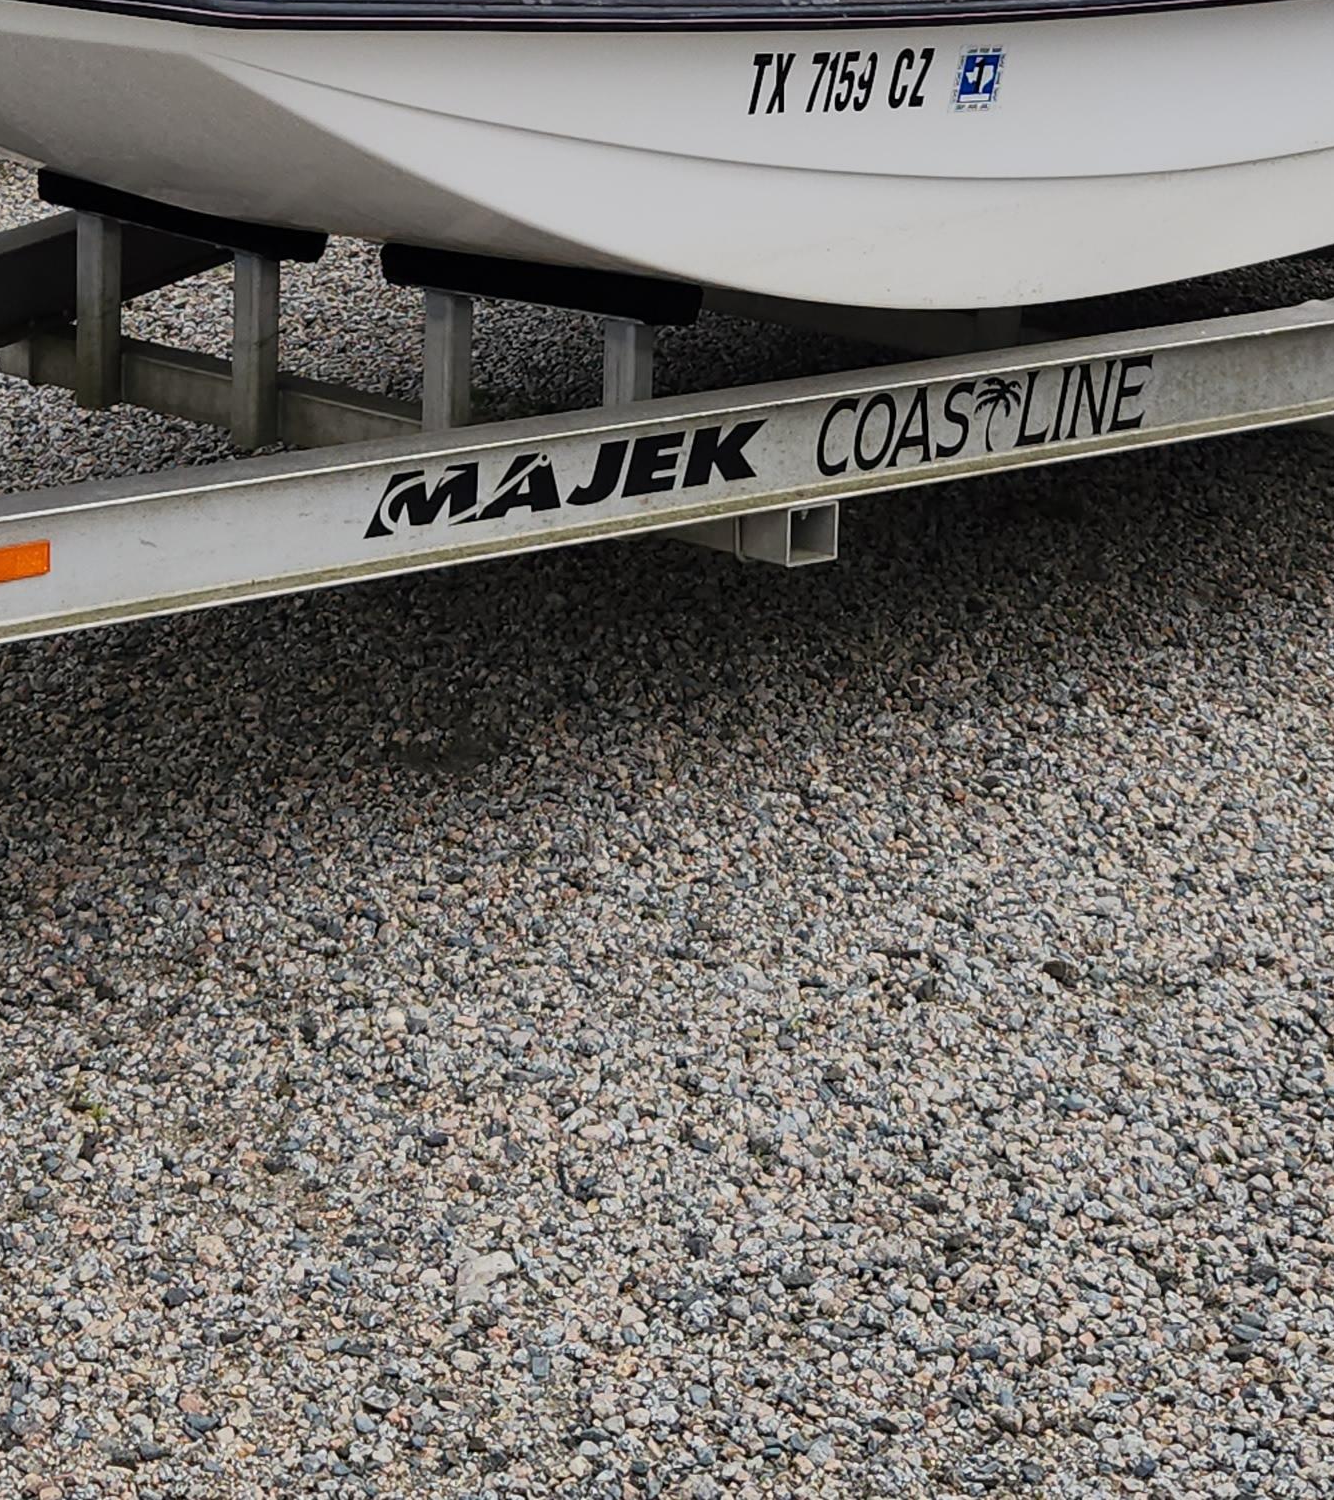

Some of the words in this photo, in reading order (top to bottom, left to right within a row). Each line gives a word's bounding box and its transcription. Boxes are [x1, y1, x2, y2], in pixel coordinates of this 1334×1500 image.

[748, 52, 797, 115] TX
[805, 51, 879, 114] 7159
[888, 47, 936, 110] CZ
[363, 418, 769, 540] MAJEK
